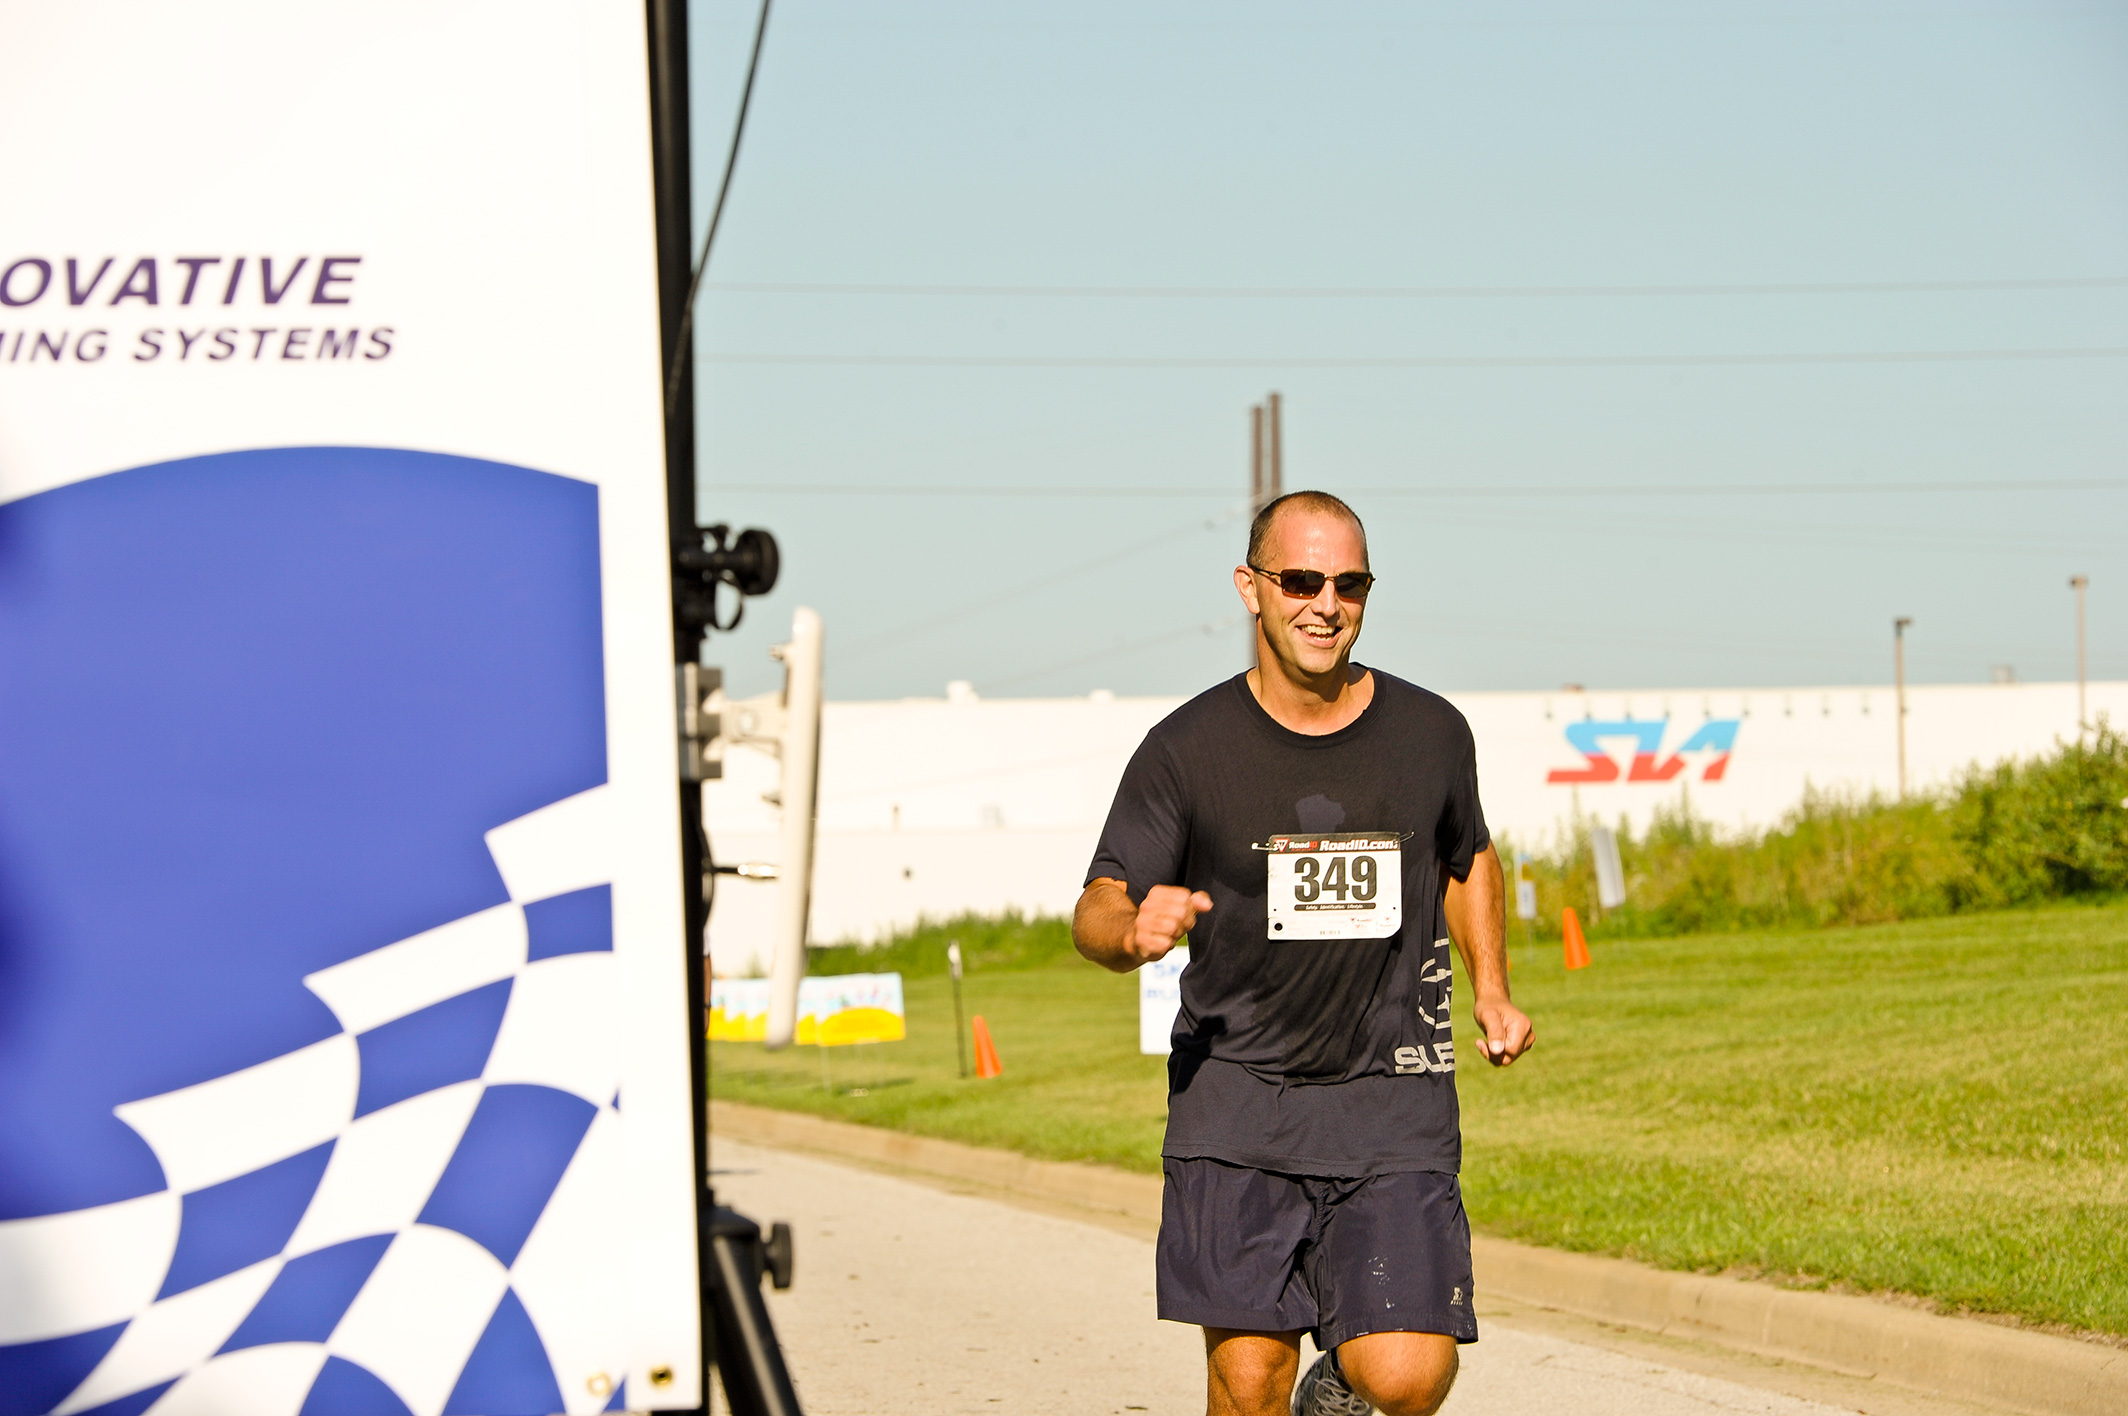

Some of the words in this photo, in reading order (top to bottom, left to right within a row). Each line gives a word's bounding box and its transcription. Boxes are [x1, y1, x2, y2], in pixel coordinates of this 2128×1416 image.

[0, 257, 363, 307] OVATIVE
[0, 327, 109, 363] ING
[133, 326, 396, 362] SYSTEMS
[1294, 855, 1378, 903] 349
